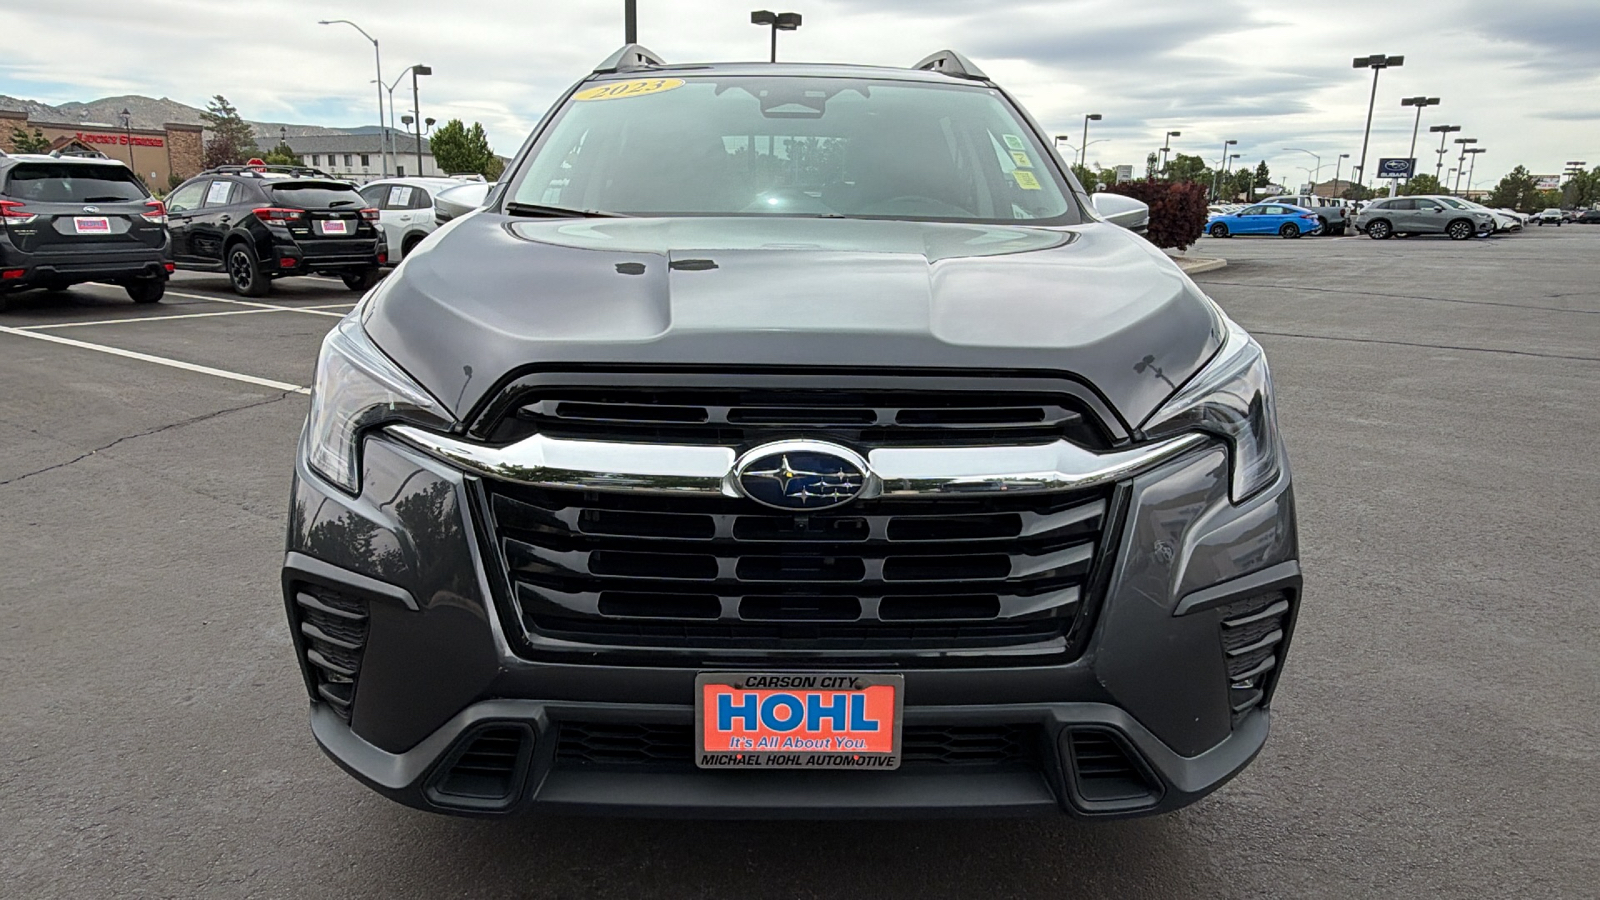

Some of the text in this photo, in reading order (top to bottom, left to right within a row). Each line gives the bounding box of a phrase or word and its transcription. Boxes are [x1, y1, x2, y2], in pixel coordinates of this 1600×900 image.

[589, 80, 667, 99] 2023
[745, 676, 858, 688] CARSON CITY
[717, 693, 880, 732] HOHL
[729, 736, 868, 749] It's All About You.
[701, 754, 896, 767] MICHAEL HOHL AUTOMOTIVE
